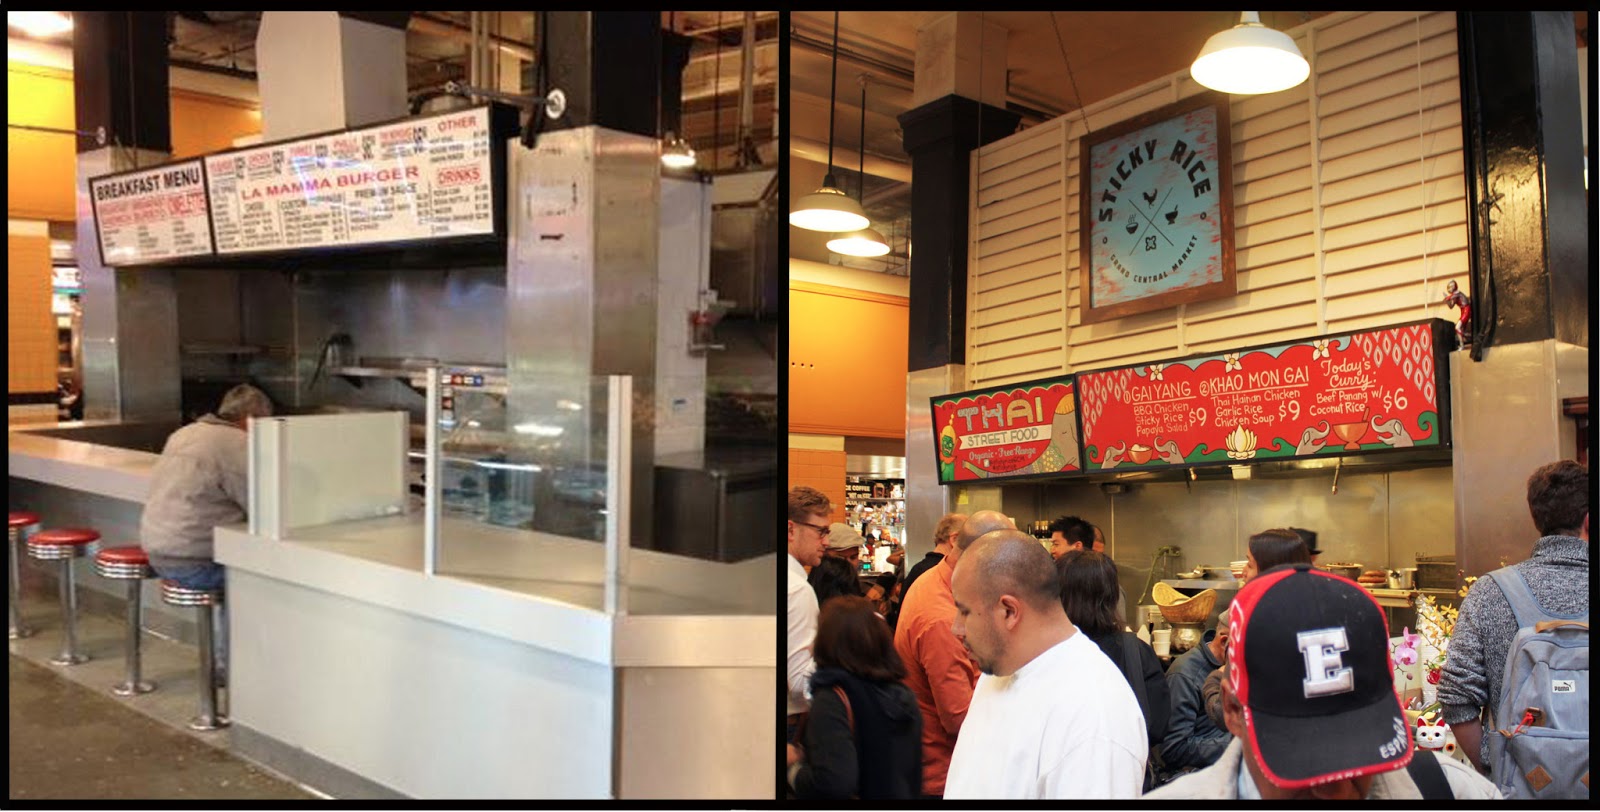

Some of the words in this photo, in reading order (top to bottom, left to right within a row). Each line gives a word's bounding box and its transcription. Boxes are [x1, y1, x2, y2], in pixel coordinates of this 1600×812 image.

[438, 116, 477, 132] OTHER
[96, 174, 160, 201] BREAKFAST
[163, 167, 200, 188] MENU
[242, 187, 262, 200] LA
[265, 178, 331, 196] MAMMA
[336, 166, 419, 187] BURGER
[438, 168, 481, 185] DRINKS
[1098, 138, 1158, 222] STICKY
[1169, 139, 1211, 198] RICE
[1110, 254, 1130, 278] GRAND
[1133, 271, 1169, 283] CENTRAL
[1172, 235, 1198, 272] MARKET
[1320, 357, 1372, 377] Today's
[1209, 374, 1243, 395] KHAO
[1248, 368, 1280, 389] MON
[1283, 365, 1309, 384] GAI
[1210, 395, 1231, 407] Thai
[1232, 393, 1262, 404] Hainan
[1263, 388, 1301, 402] Chicken
[1316, 390, 1337, 403] Beef
[1338, 390, 1369, 404] Panang
[1383, 388, 1408, 413] $6
[957, 396, 1044, 432] THAI
[1133, 404, 1153, 416] BBQ
[1154, 402, 1190, 414] Chicken
[1188, 407, 1208, 427] $9
[1215, 405, 1242, 418] Garlic
[1244, 404, 1264, 415] Rice
[1278, 400, 1301, 422] $9
[1309, 403, 1343, 416] Coconut
[1345, 401, 1367, 413] Rice
[1134, 415, 1161, 426] Sticky
[1163, 412, 1184, 424] Rice
[1214, 414, 1250, 428] Chicken
[1252, 413, 1276, 427] Soup
[967, 431, 1008, 448] STREET
[1010, 427, 1040, 444] FOOD
[1135, 424, 1164, 438] Papaya
[1166, 421, 1189, 433] Salad
[968, 449, 995, 465] Organic
[1297, 626, 1355, 699] E
